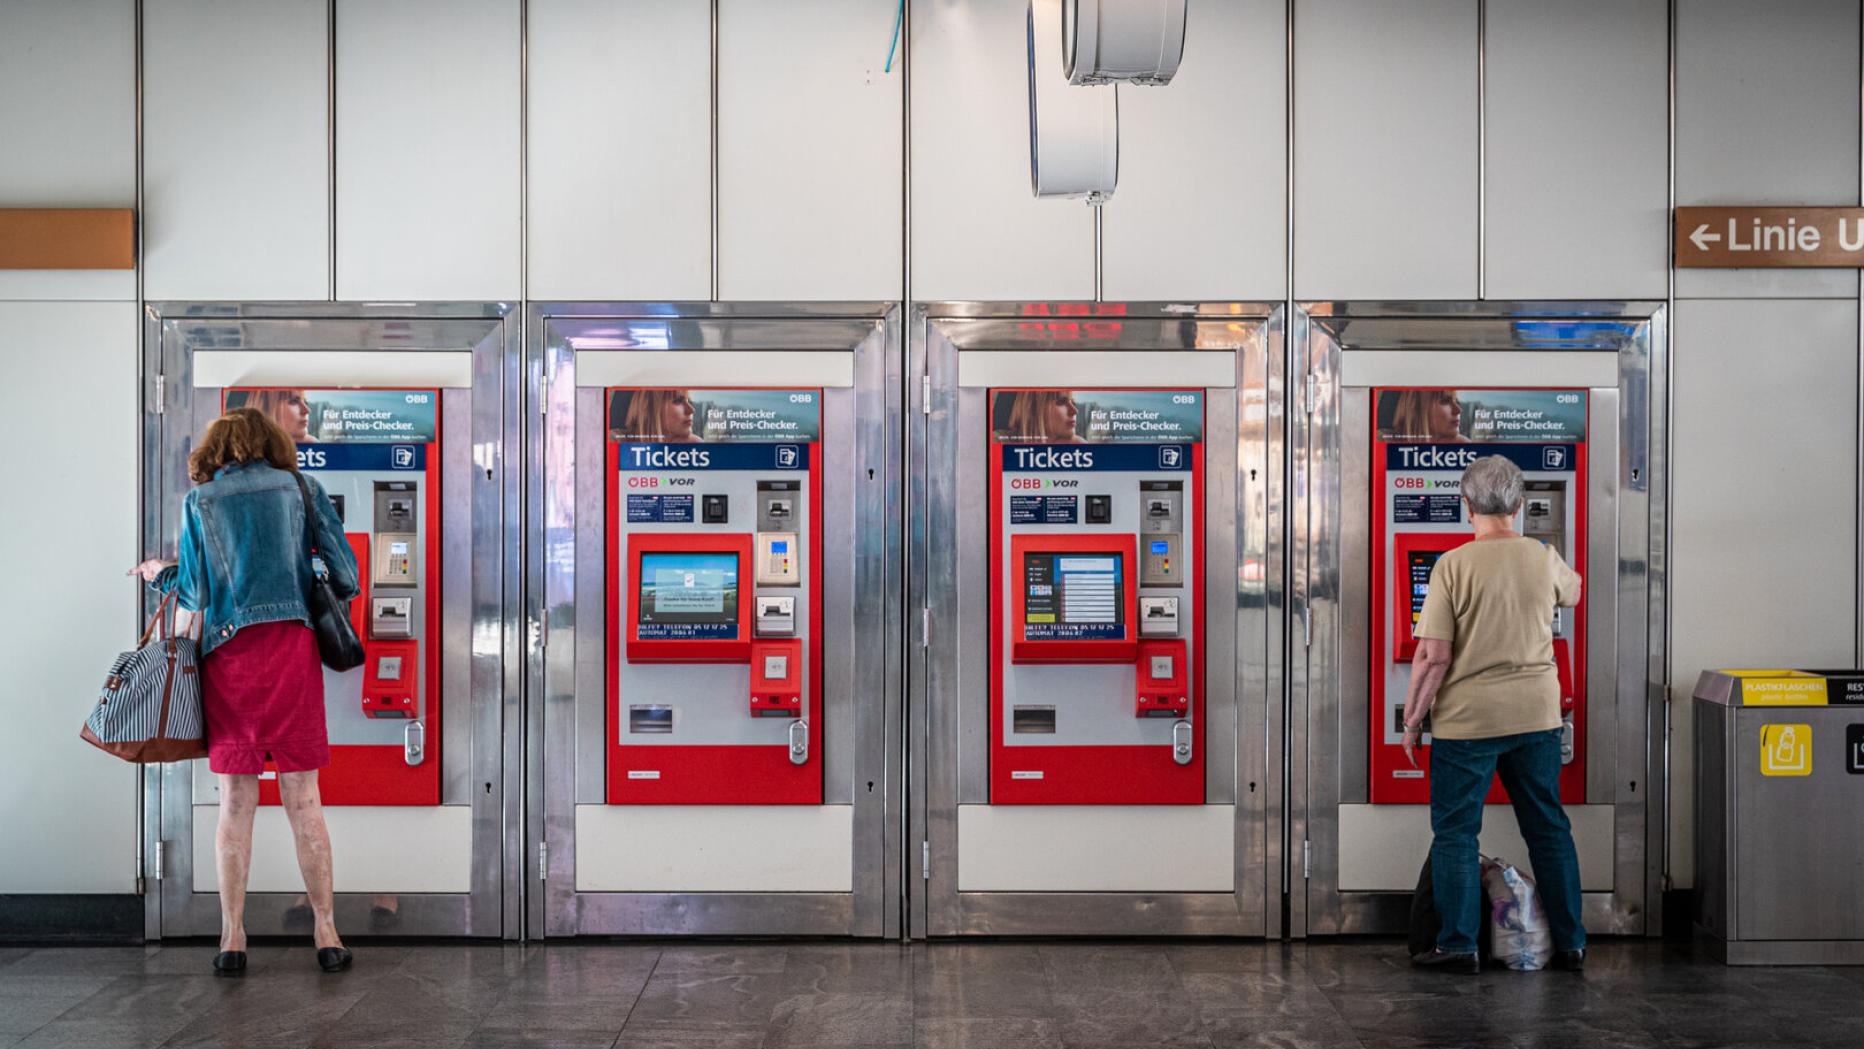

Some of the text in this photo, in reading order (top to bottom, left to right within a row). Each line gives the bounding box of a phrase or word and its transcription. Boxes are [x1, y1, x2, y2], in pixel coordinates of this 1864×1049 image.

[1728, 217, 1821, 251] Linie
[405, 394, 428, 404] ÖBB
[790, 394, 812, 403] ÖBB
[1172, 395, 1195, 404] ÖBB
[1556, 394, 1578, 403] ÖBB
[323, 409, 392, 419] Für Entdecker
[708, 409, 776, 419] Für Entdecker
[1091, 410, 1159, 420] Für Entdecker
[1474, 409, 1543, 419] Für Entdecker
[323, 420, 414, 430] und Preis-Checker.
[708, 420, 798, 430] und Preis-Checker.
[1091, 421, 1182, 431] und Preis-Checker.
[1474, 420, 1565, 430] und Preis-Checker.
[630, 446, 710, 467] Tickets
[1014, 447, 1093, 468] Tickets
[1398, 446, 1477, 467] Tickets
[628, 477, 695, 488] ÖBB VOR
[1011, 478, 1078, 489] ÖBB VOR
[1394, 478, 1460, 488] ÖBB VOR
